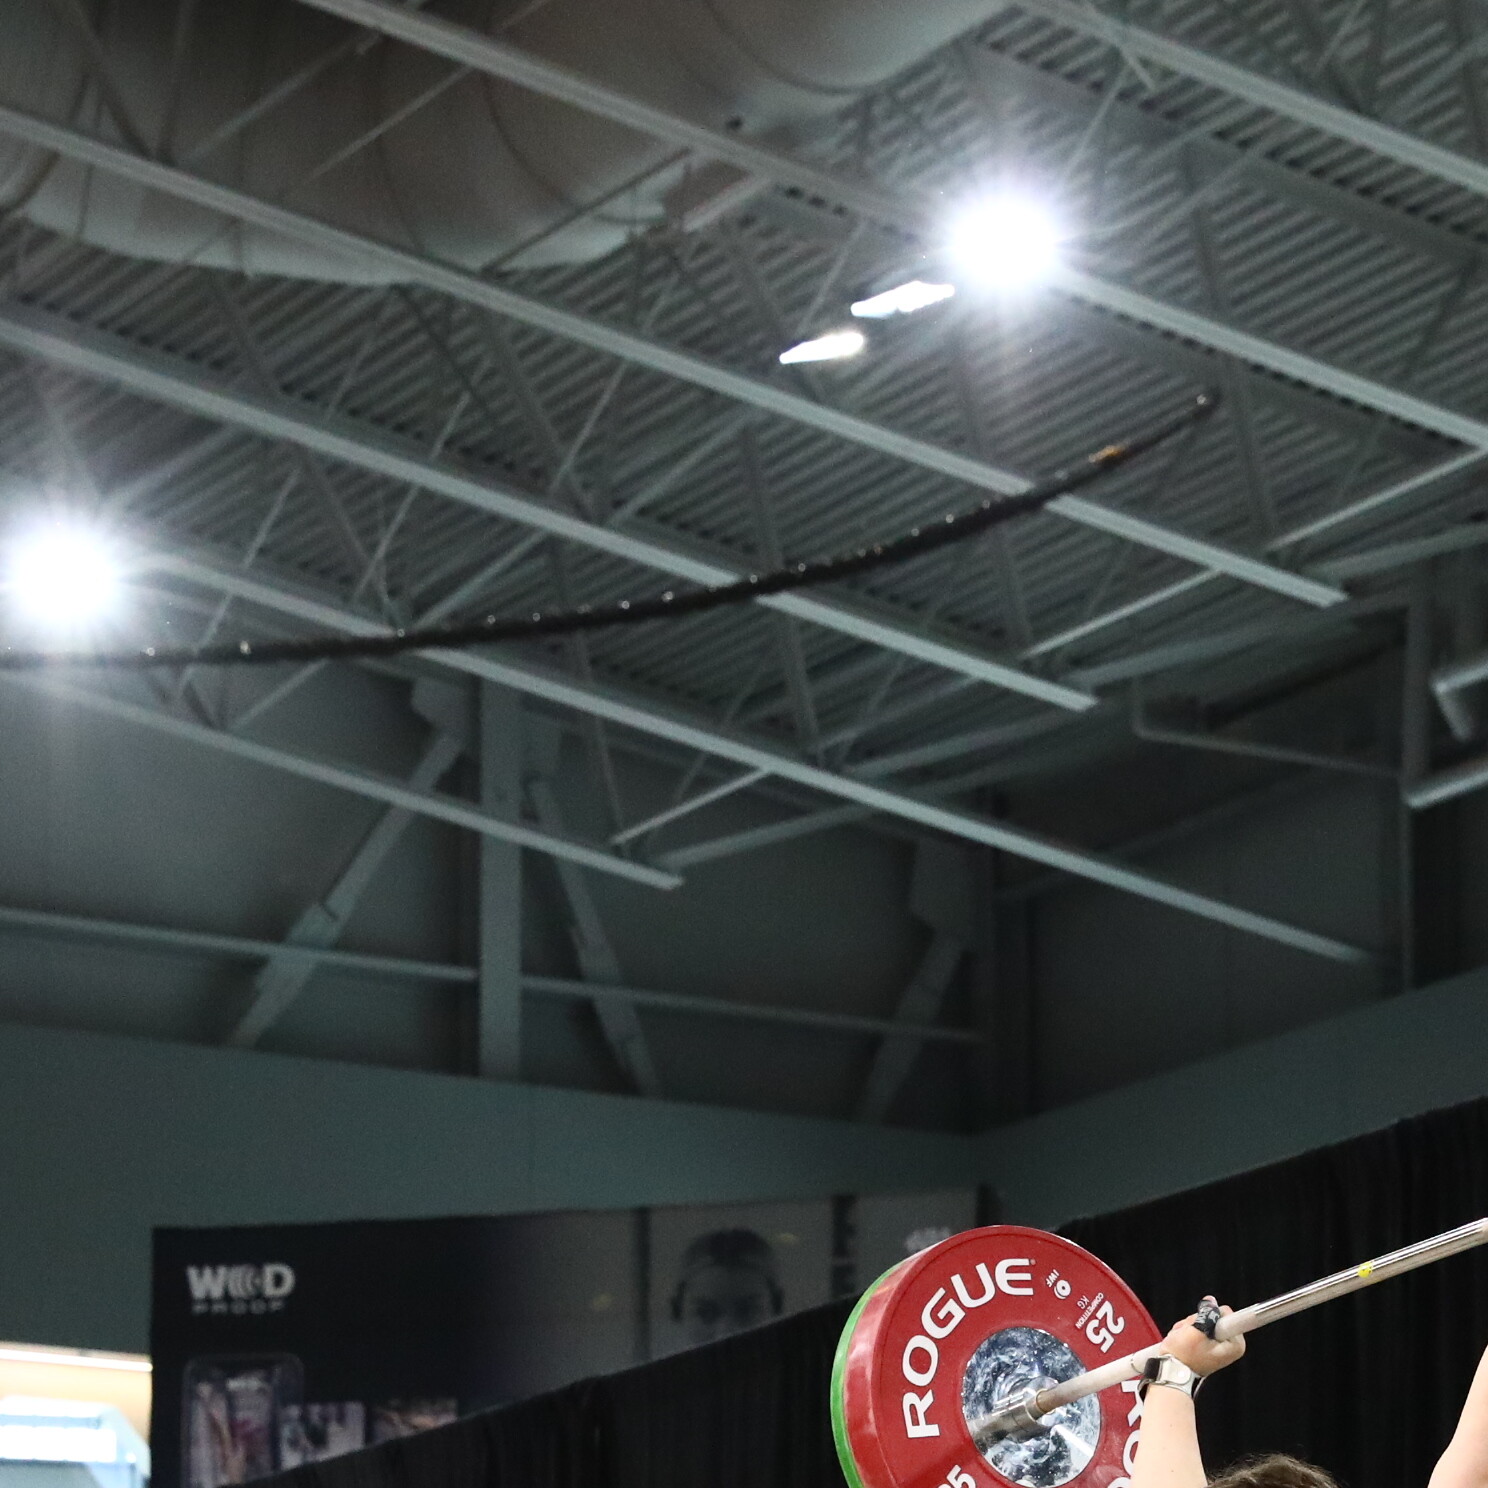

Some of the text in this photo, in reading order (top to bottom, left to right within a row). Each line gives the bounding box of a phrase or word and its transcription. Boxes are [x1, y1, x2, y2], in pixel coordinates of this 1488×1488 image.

[1045, 1269, 1060, 1288] IWF
[1074, 1292, 1104, 1330] COMPETITION
[1085, 1300, 1125, 1354] 25
[901, 1257, 1035, 1439] ROGUE
